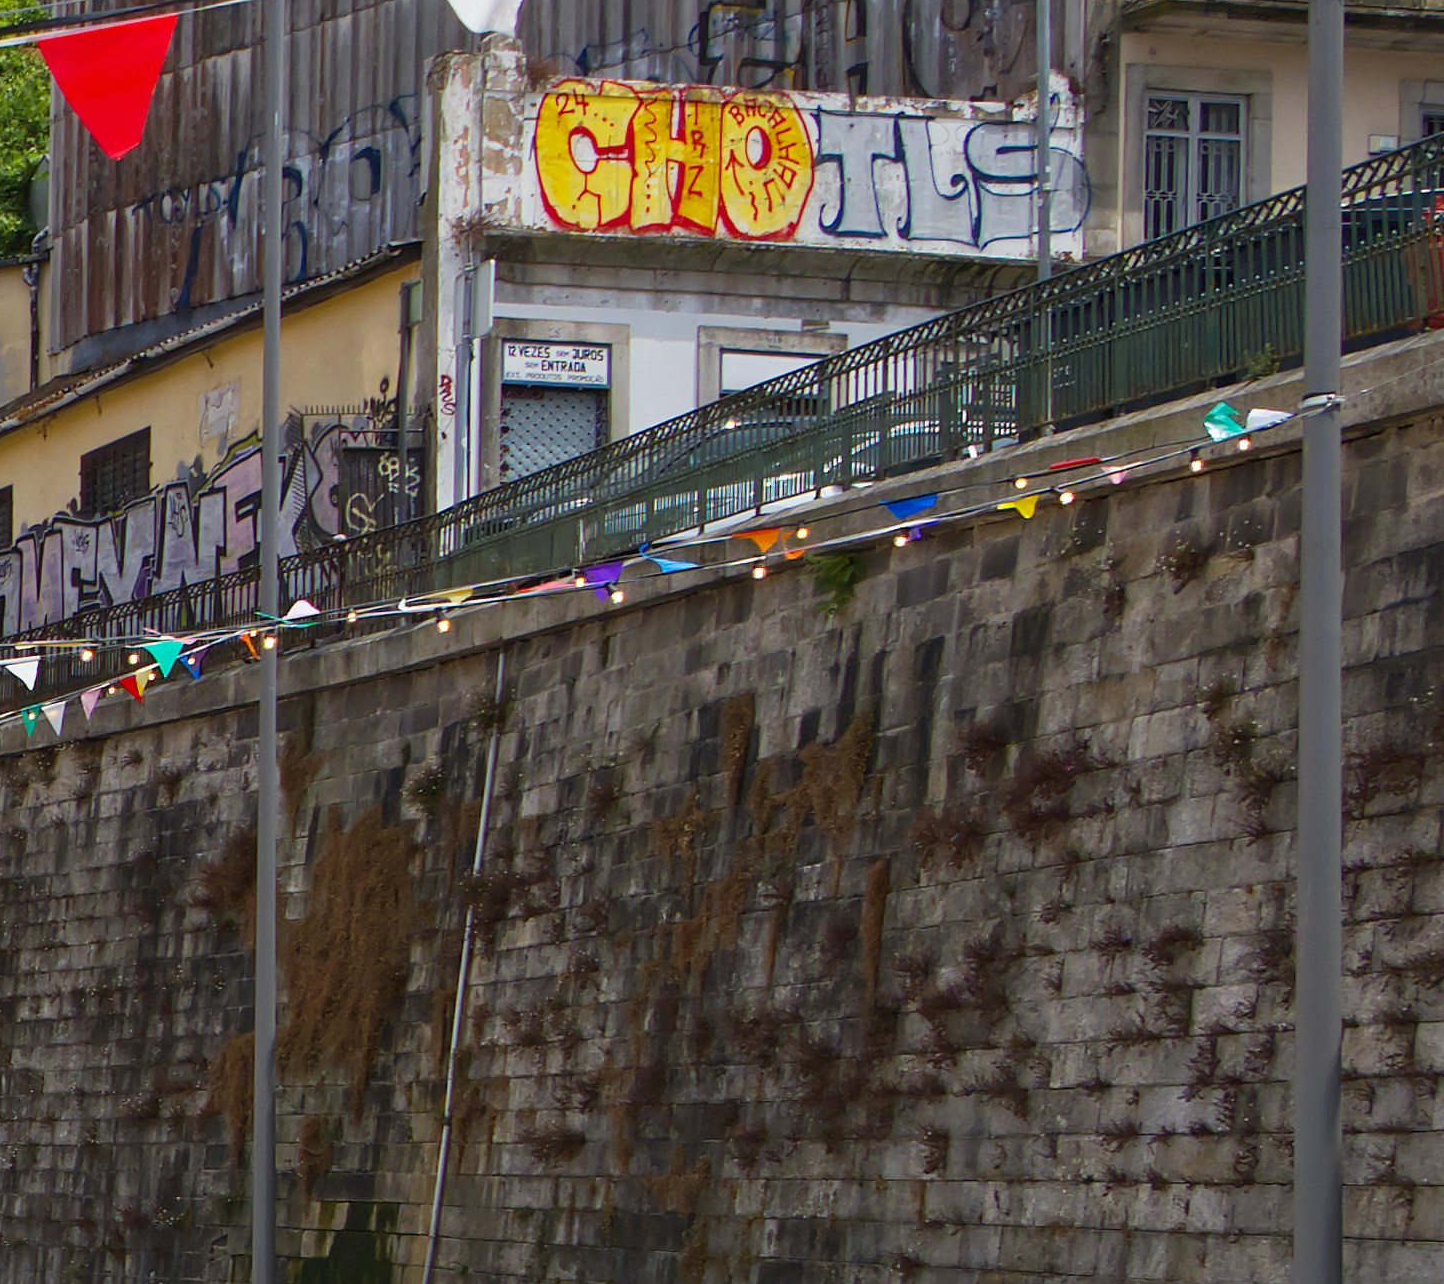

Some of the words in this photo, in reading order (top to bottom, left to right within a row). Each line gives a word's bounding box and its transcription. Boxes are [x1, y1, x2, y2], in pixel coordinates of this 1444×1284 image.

[518, 345, 550, 359] VEZES
[572, 348, 605, 362] JUROS
[541, 360, 586, 373] ENTRADA
